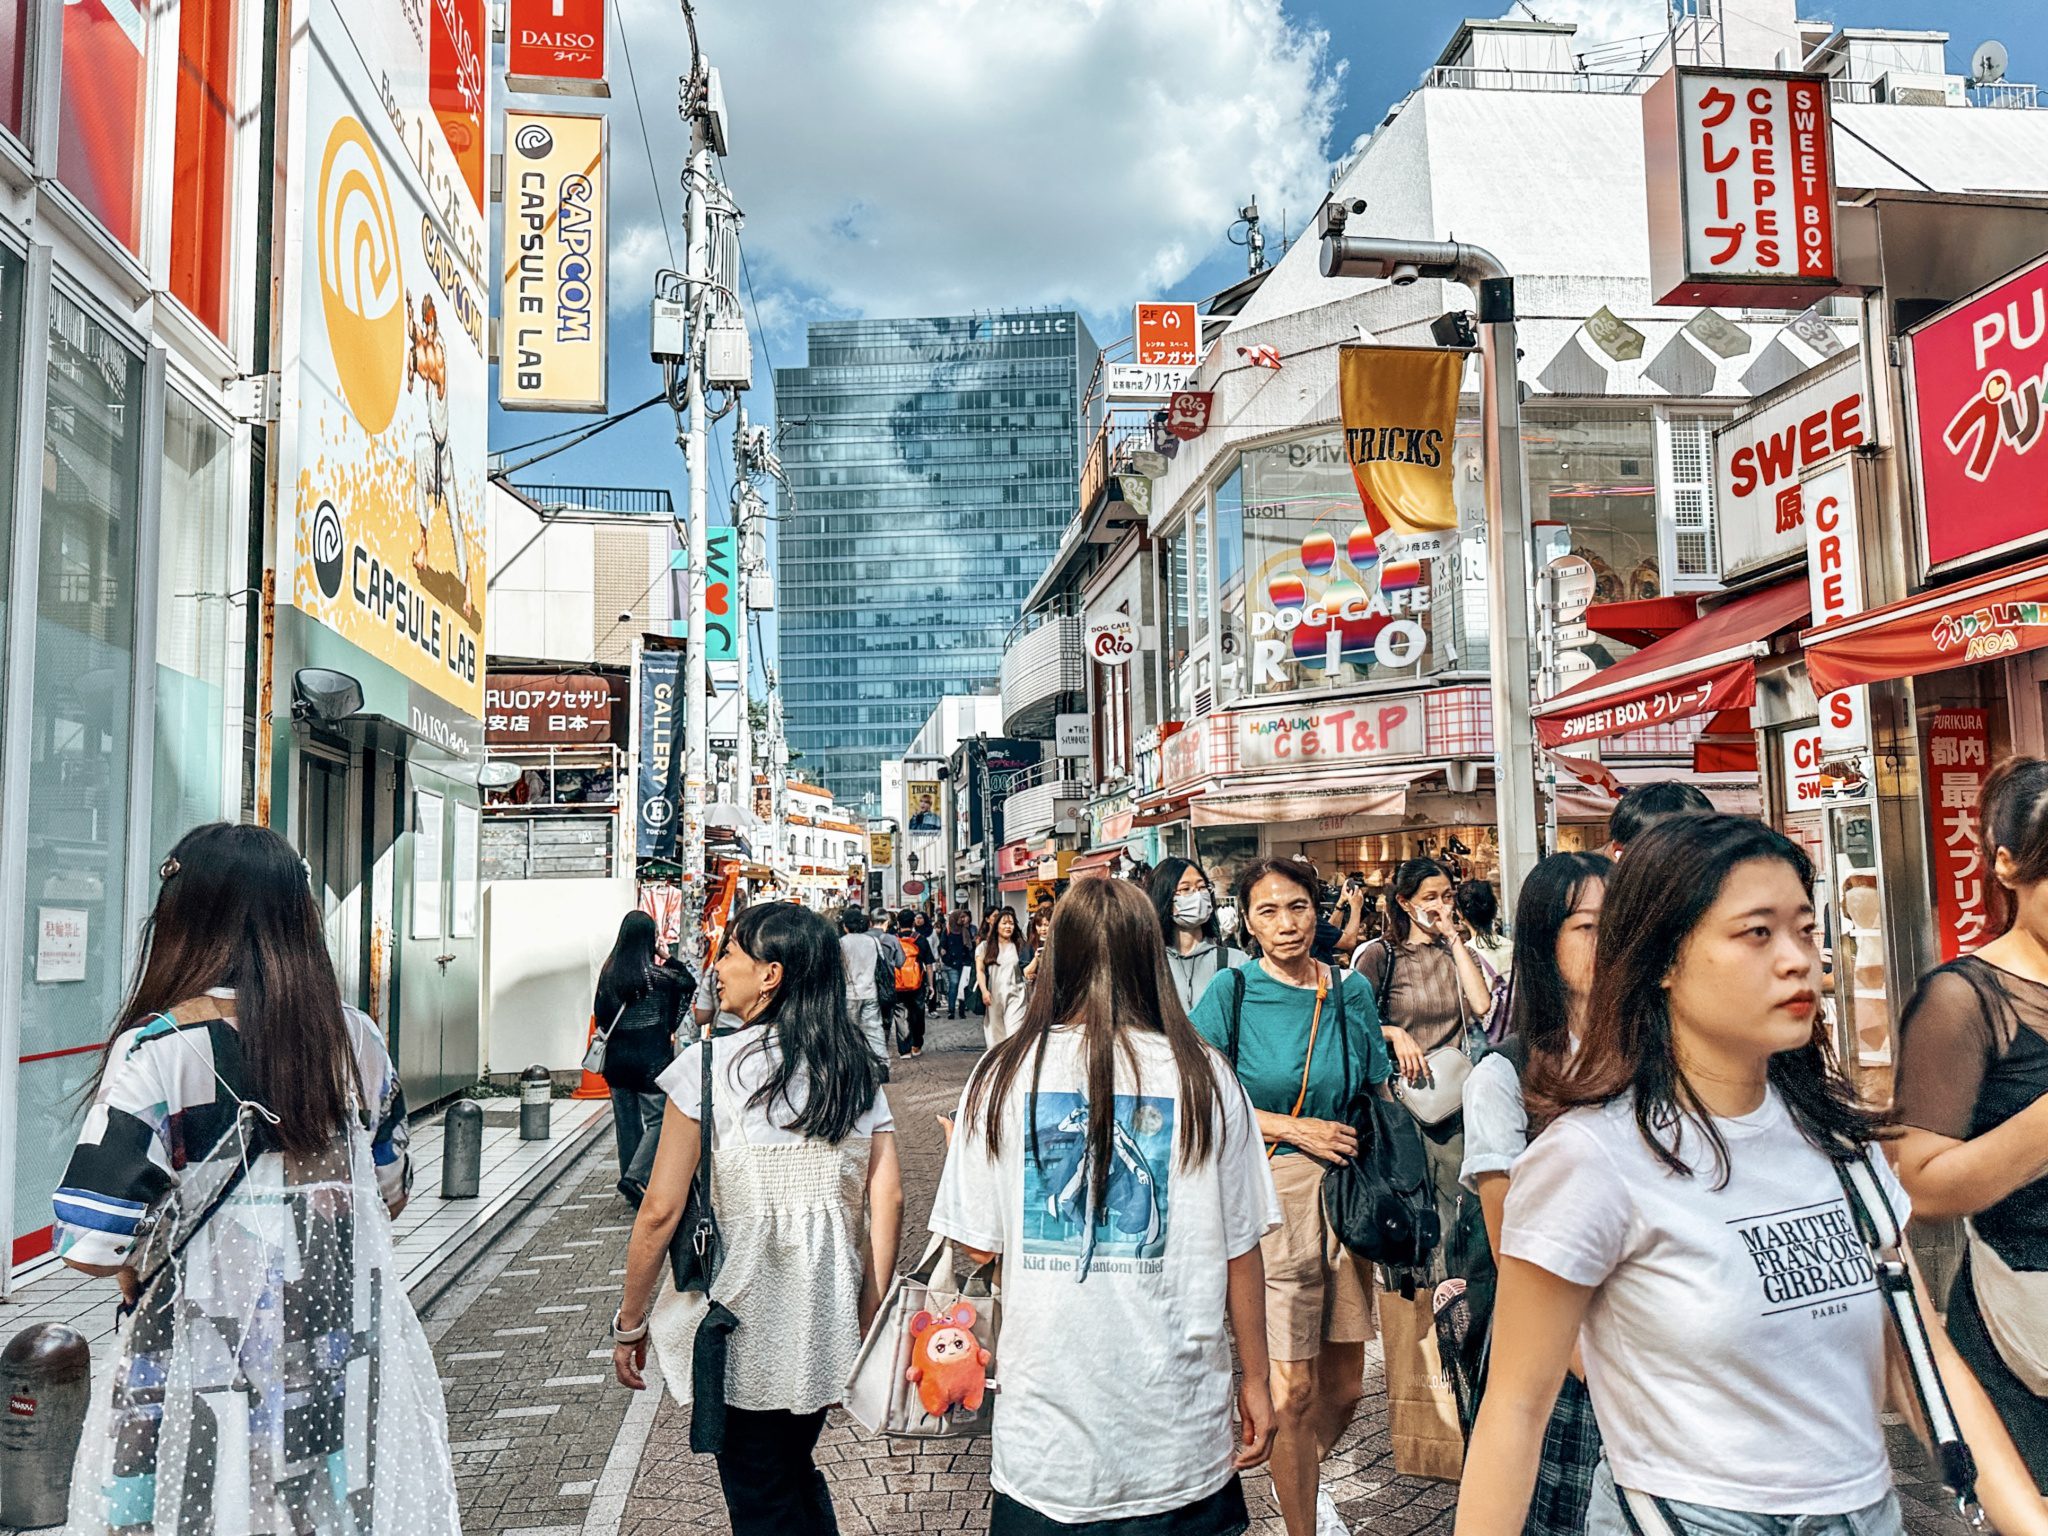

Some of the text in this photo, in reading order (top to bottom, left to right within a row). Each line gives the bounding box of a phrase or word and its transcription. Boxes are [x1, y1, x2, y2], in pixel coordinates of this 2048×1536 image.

[521, 30, 595, 49] DAISO
[381, 69, 407, 142] Floor
[1698, 87, 1746, 265] クレープ
[1747, 88, 1780, 267] CREPES
[1794, 90, 1823, 269] SWEET BOX
[557, 174, 593, 343] CAPCOM
[422, 213, 484, 359] CAPCOM
[518, 172, 545, 390] CAPSULE LAB
[992, 319, 1067, 336] HULIC
[1142, 310, 1157, 319] 2F
[1153, 351, 1195, 364] アガサ
[1175, 394, 1206, 411] Rio
[1943, 362, 2048, 482] プリ
[1346, 427, 1443, 468] TRICKS
[1731, 393, 1864, 498] SWEE
[352, 545, 476, 684] CAPSULE LAB
[1091, 622, 1130, 633] DOG CAFE
[1251, 586, 1431, 636] DOG CAFE
[1932, 602, 2048, 651] プリクラ LAND
[1095, 632, 1133, 656] Rio
[1252, 620, 1427, 686] RIO
[1965, 630, 2018, 662] NOA
[412, 706, 449, 747] DAISO
[484, 715, 610, 731] 安店 日本一
[1250, 716, 1319, 735] HARAJUKU
[1561, 681, 1713, 739] SWEET BOX クレープ
[1933, 714, 1983, 730] PURIKURA
[652, 683, 672, 787] GALLERY
[1931, 736, 1985, 766] 都内
[911, 785, 938, 795] TRICKS
[645, 828, 668, 836] TOKYO
[1941, 772, 1986, 958] 最大プリク
[1023, 1256, 1046, 1271] Kid
[1049, 1257, 1071, 1272] the
[1136, 1260, 1164, 1274] Thief
[1763, 1256, 1876, 1304] GIRBAUD
[1811, 1303, 1849, 1319] PARIS
